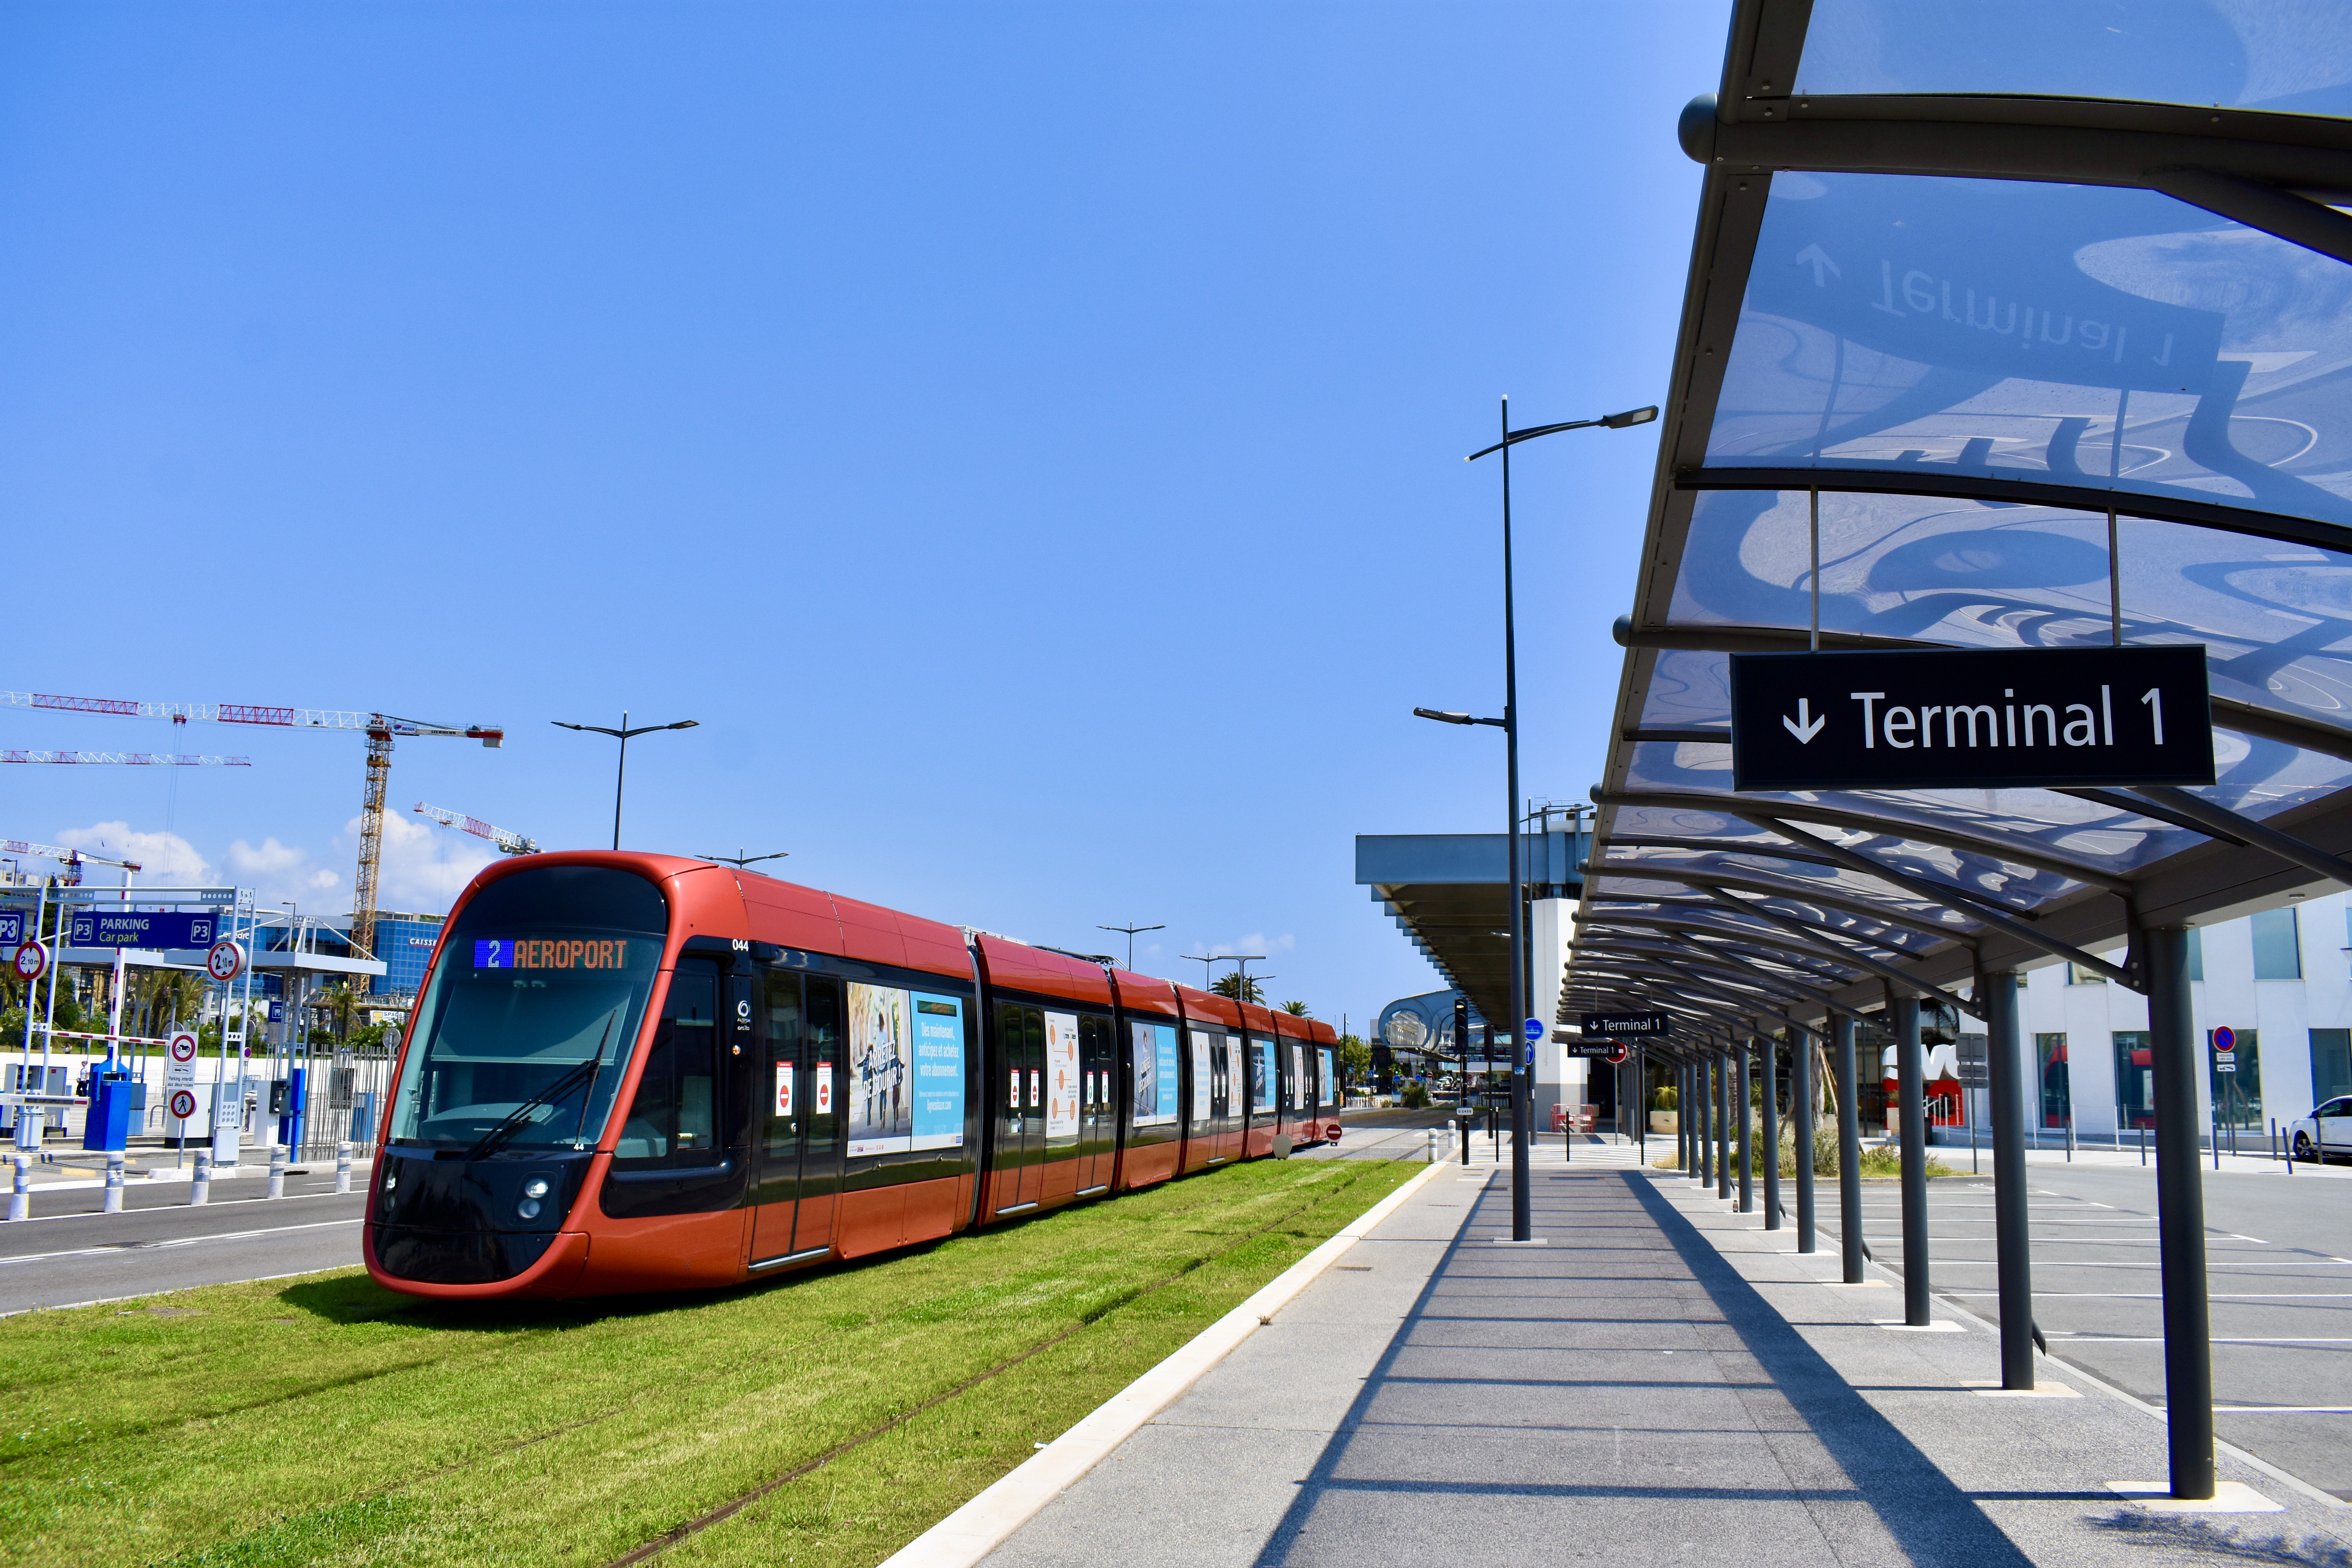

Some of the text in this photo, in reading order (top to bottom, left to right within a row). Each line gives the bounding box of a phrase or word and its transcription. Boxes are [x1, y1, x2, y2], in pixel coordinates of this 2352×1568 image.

[1851, 684, 2164, 750] Terminal 1
[0, 920, 17, 938] P3
[76, 924, 90, 936] P3
[100, 918, 149, 930] PARKING
[193, 925, 208, 937] P3
[100, 931, 138, 944] Car park
[733, 938, 749, 952] 044
[488, 940, 627, 969] 2 AEROPORT
[921, 1022, 955, 1040] Dès maintenant,
[1602, 1018, 1660, 1031] Terminal 1
[868, 1039, 896, 1071] ARRÊTEZ
[918, 1042, 959, 1060] anticipez et achetez
[920, 1062, 958, 1077] votre abonnement.
[864, 1078, 872, 1101] DE
